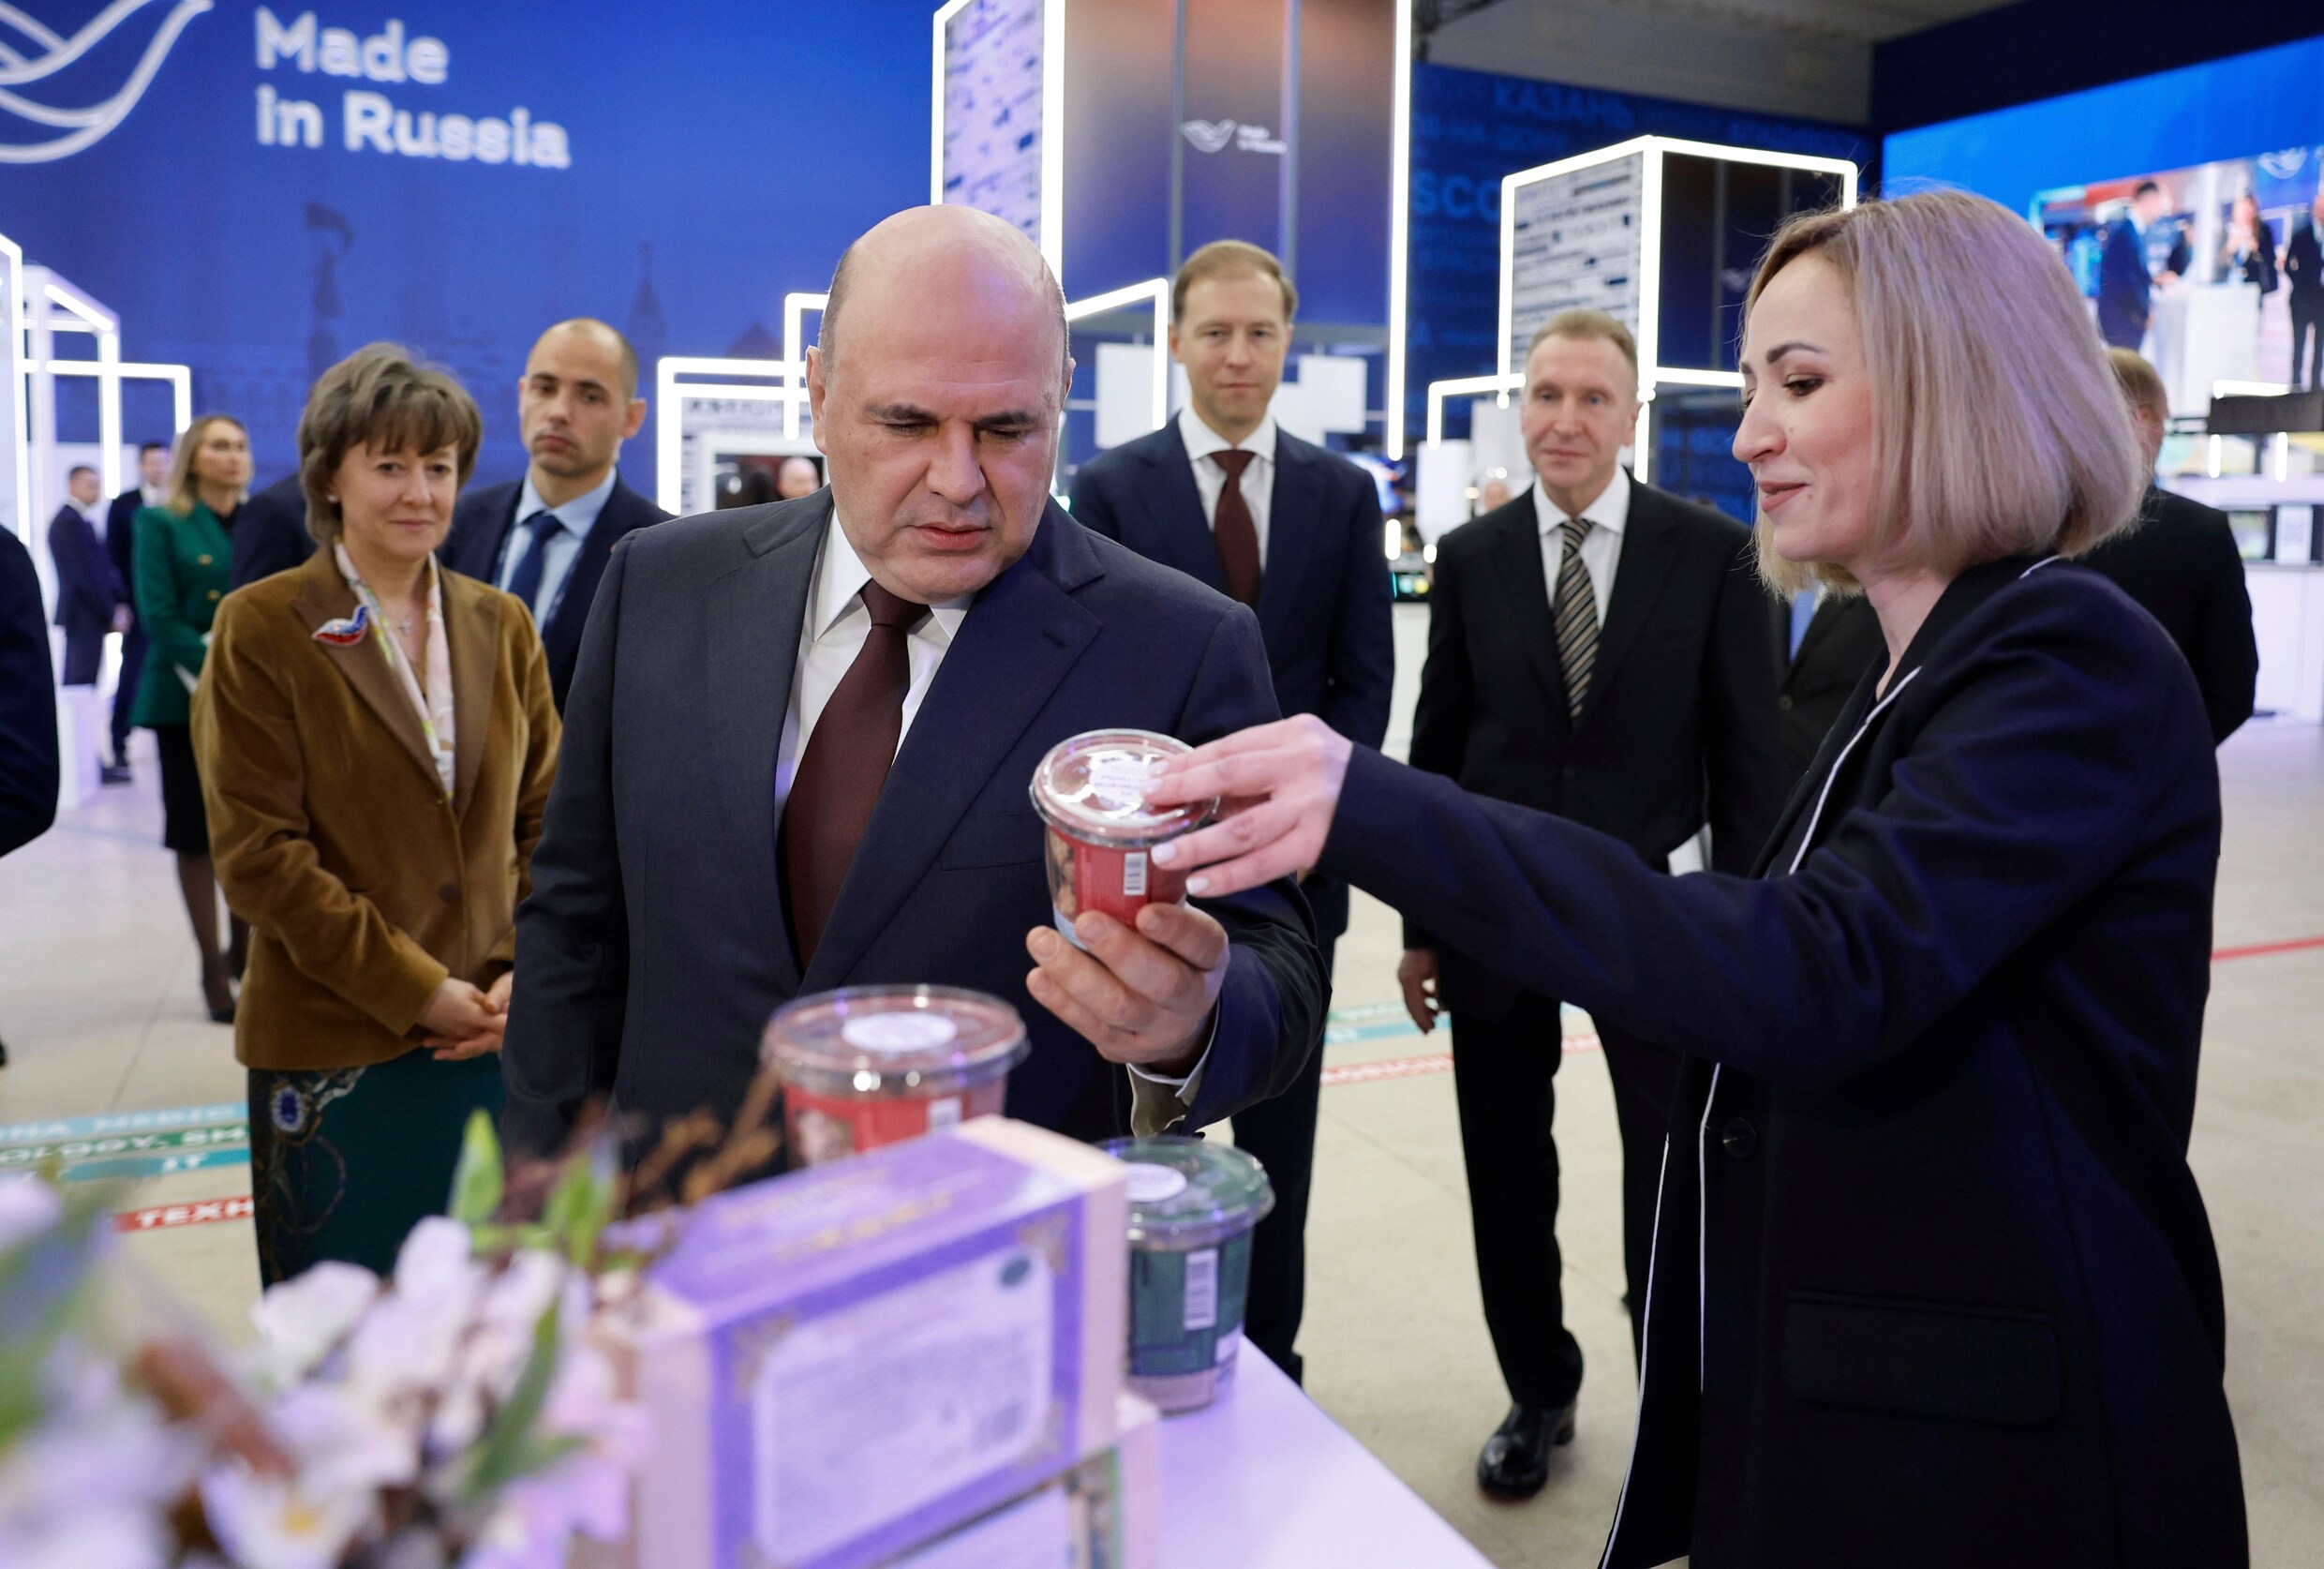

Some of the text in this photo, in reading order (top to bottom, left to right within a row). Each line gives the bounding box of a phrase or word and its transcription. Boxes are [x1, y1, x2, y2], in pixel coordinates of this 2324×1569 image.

[256, 6, 448, 83] Made
[255, 83, 571, 169] in Russia
